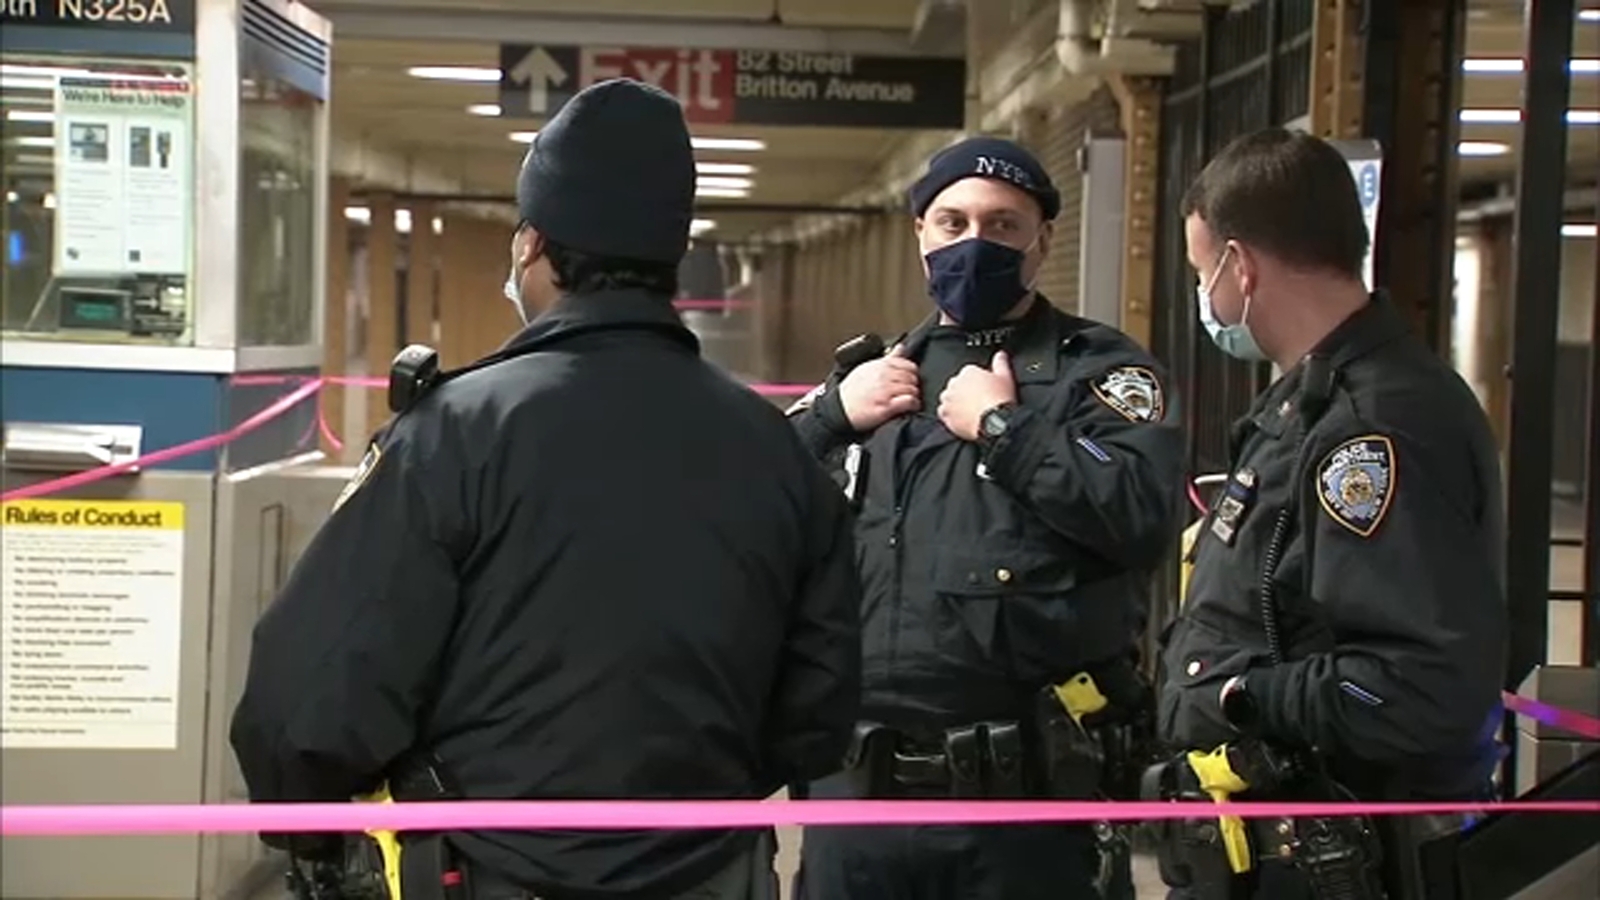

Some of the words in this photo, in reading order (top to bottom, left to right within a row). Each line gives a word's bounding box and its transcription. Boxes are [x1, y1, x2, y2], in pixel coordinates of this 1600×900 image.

[58, 0, 171, 23] N325A
[736, 49, 771, 71] 82
[778, 50, 853, 75] Street
[735, 73, 818, 99] Britton
[823, 78, 915, 102] Avenue
[5, 505, 58, 524] Rules
[61, 508, 80, 526] of
[83, 508, 162, 528] Conduct
